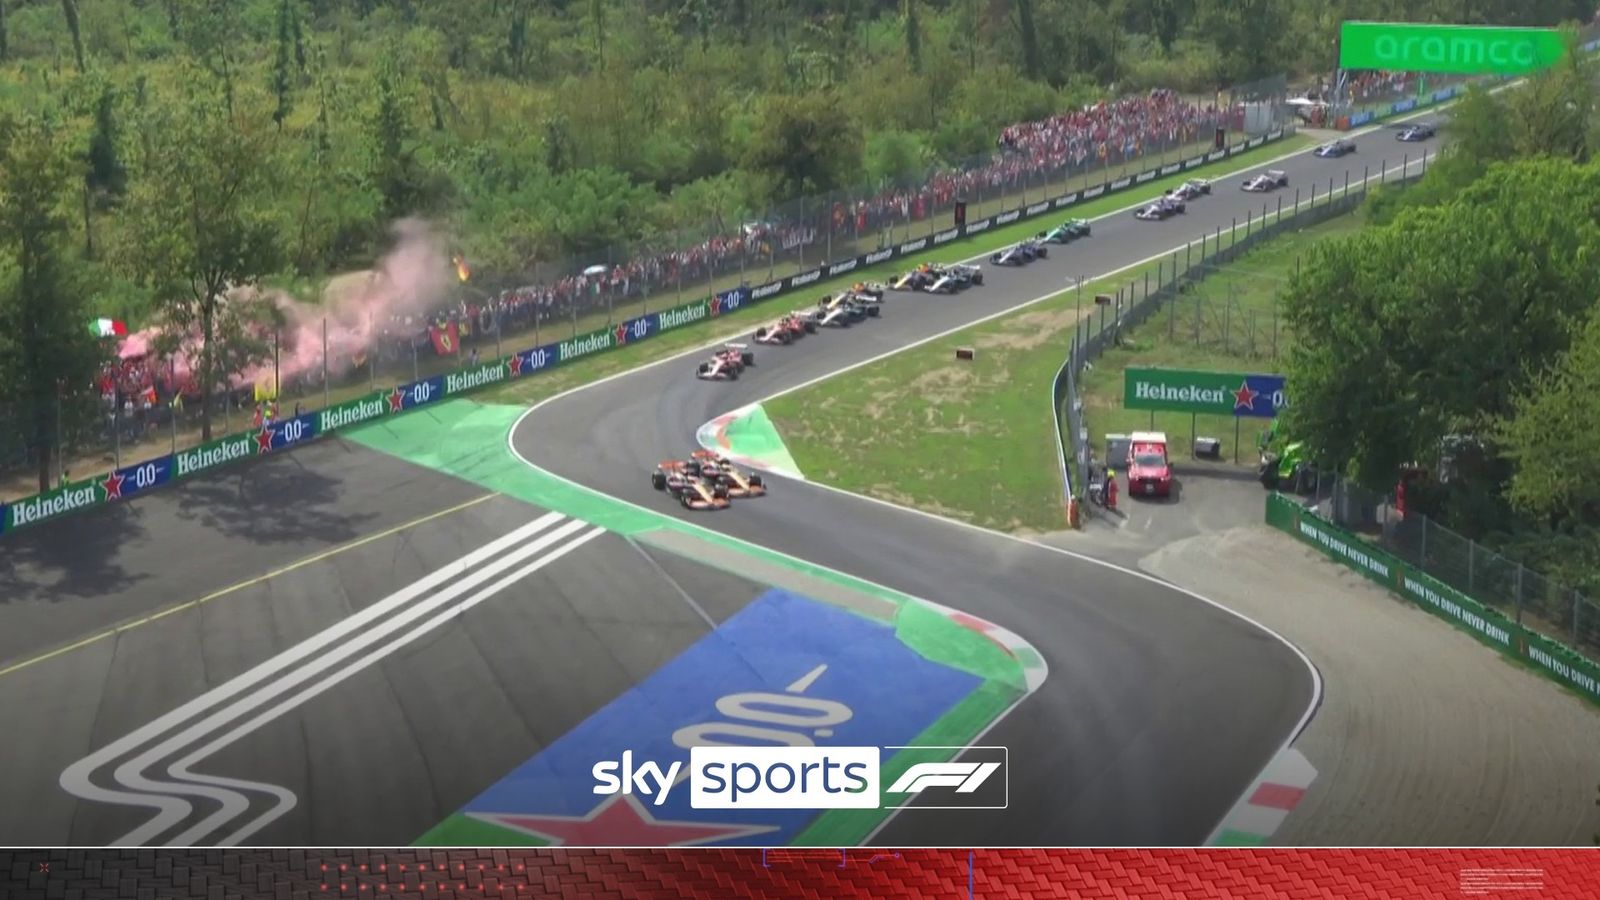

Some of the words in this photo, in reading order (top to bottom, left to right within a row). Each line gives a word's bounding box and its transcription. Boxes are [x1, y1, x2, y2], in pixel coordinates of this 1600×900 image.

[659, 304, 705, 331] Heineken
[560, 332, 610, 362] Heineken
[446, 363, 504, 394] Heineken
[1135, 381, 1224, 403] Heineken
[320, 398, 383, 431] Heineken
[177, 439, 250, 476] Heineken
[13, 486, 95, 526] Heineken
[1301, 521, 1317, 540] WHEN
[1318, 529, 1330, 546] YOU
[1404, 576, 1424, 598] WHEN
[1425, 588, 1440, 607] YOU
[1441, 596, 1461, 619] DRIVE
[1462, 608, 1485, 632] NEVER
[1486, 621, 1510, 646] DRINK
[1529, 644, 1551, 669] WHEN
[1552, 658, 1569, 678] YOU
[1571, 668, 1594, 692] DRIVE
